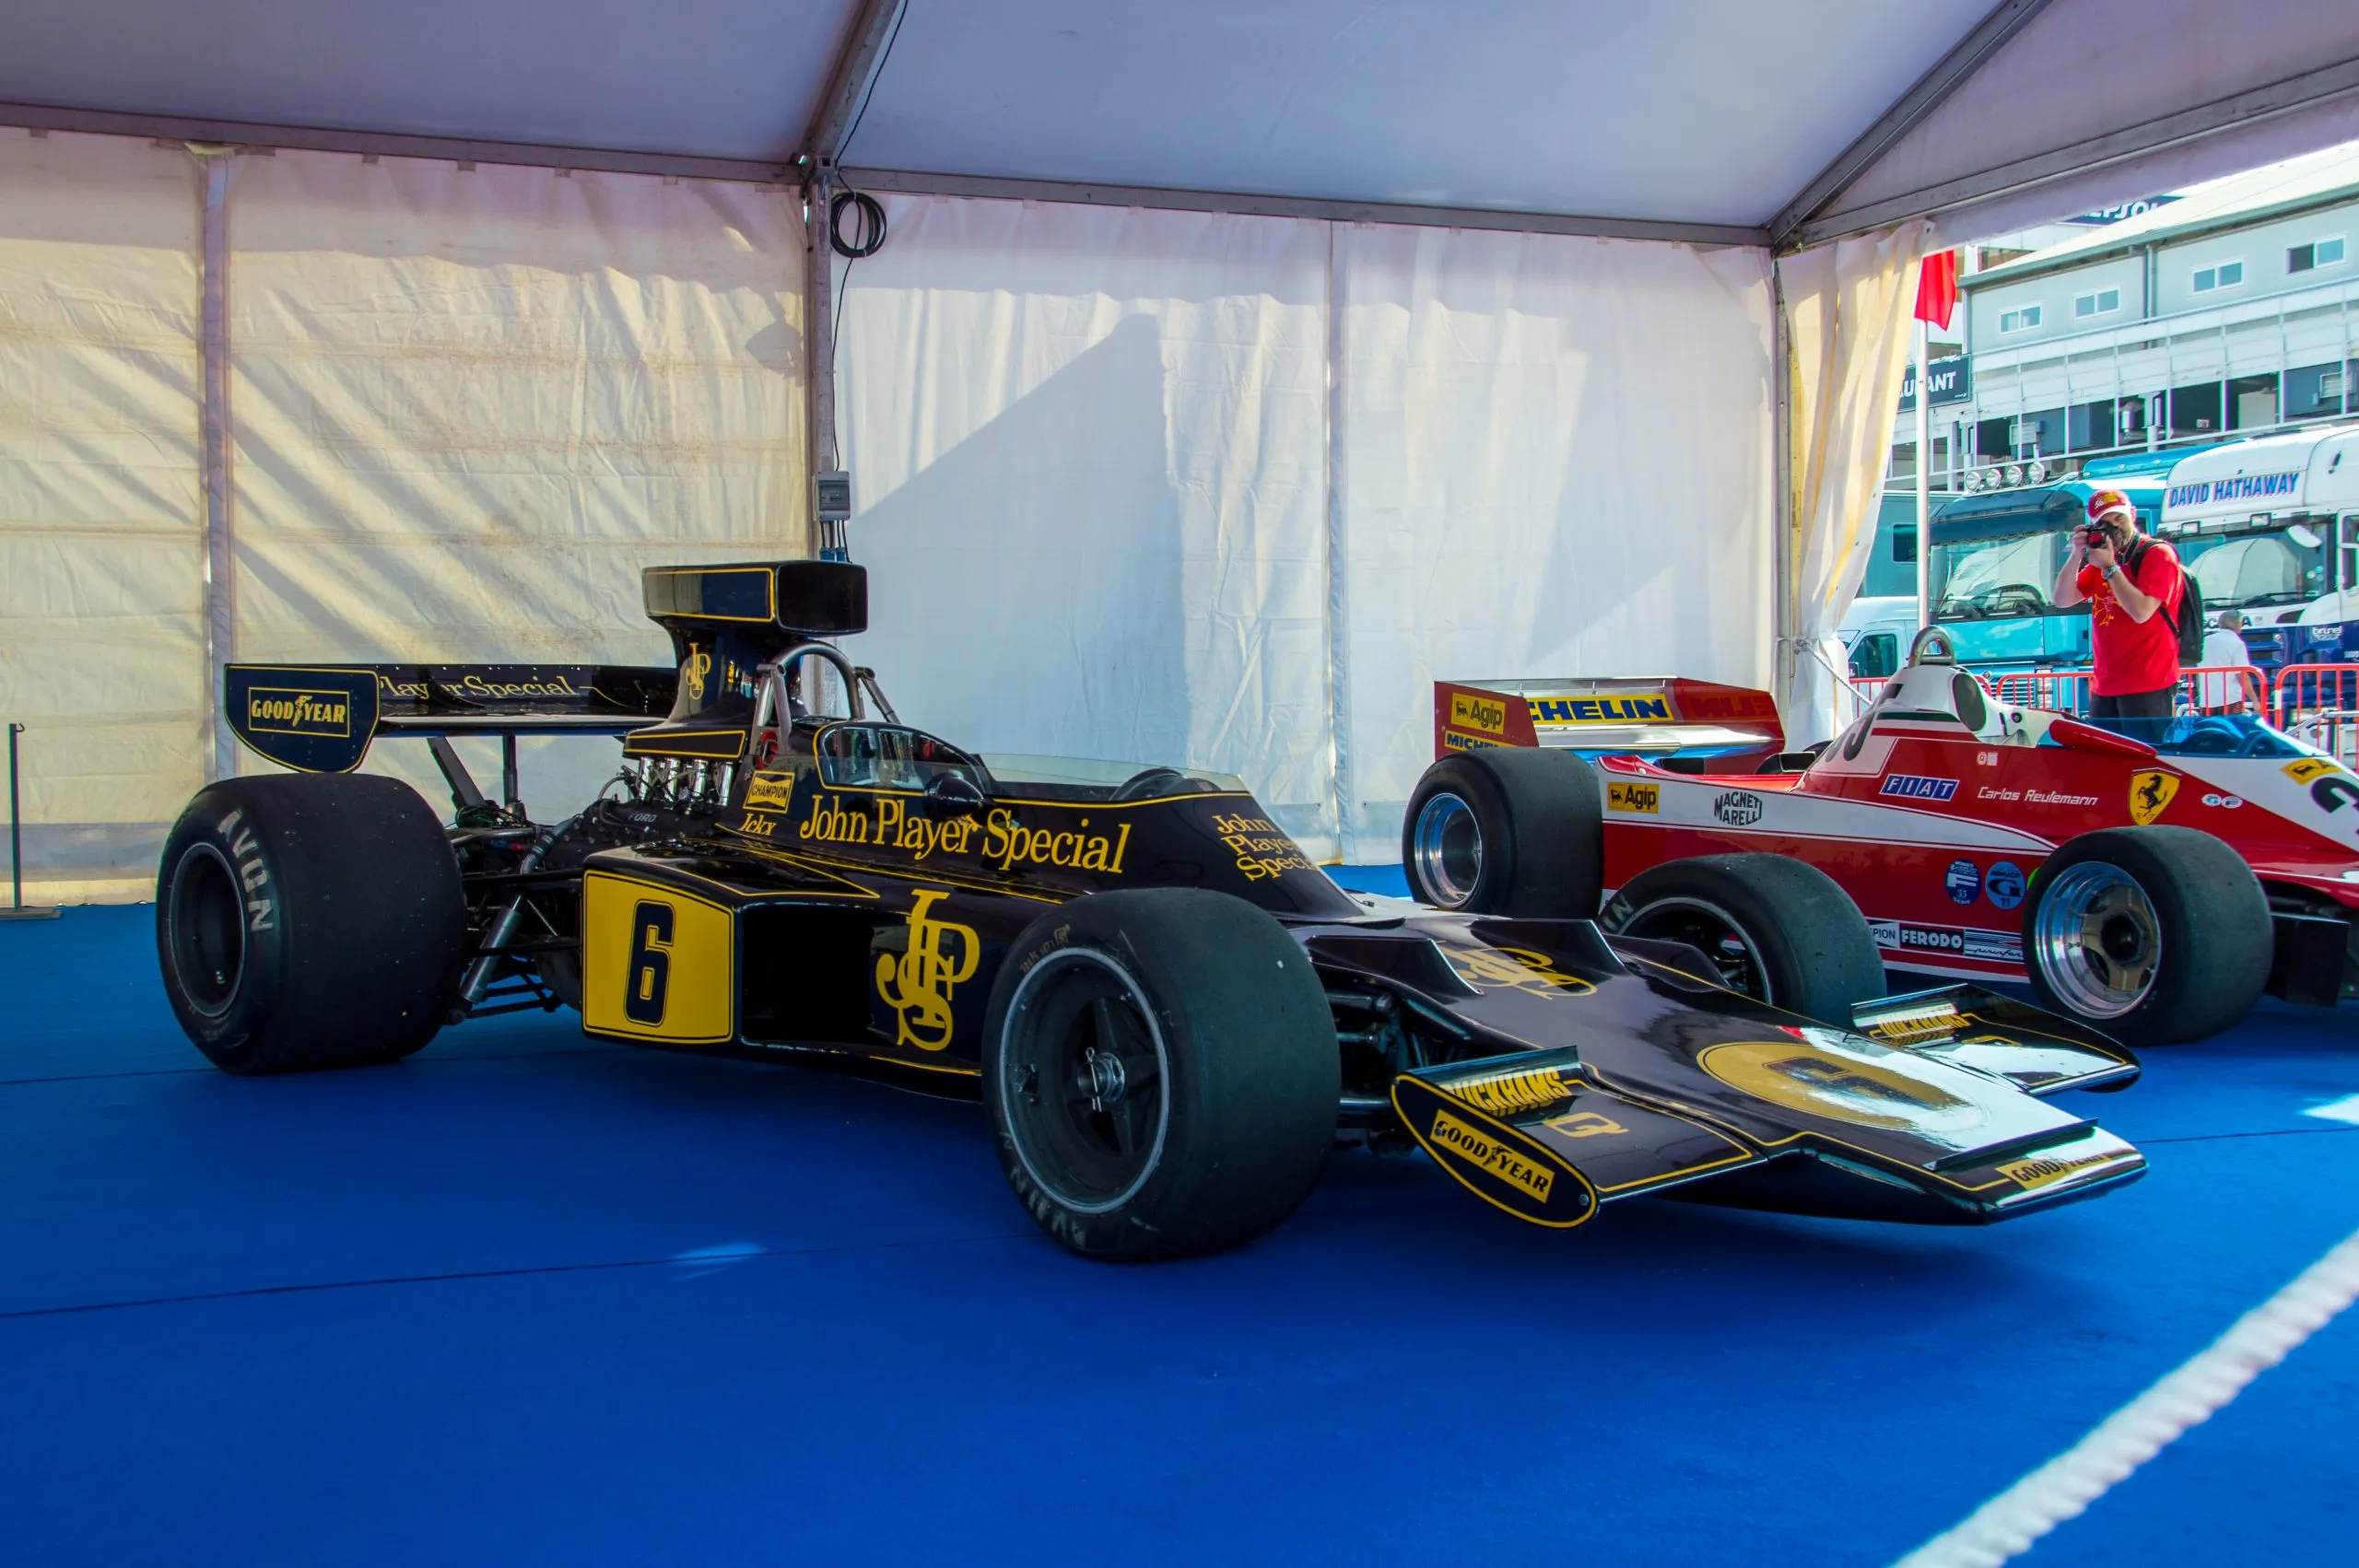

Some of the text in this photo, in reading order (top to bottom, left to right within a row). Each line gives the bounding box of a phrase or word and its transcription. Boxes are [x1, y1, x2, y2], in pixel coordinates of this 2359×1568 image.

[1899, 371, 1956, 398] UANT
[2168, 472, 2300, 508] DAVID HATHAWAY
[380, 675, 580, 700] layr Special
[1470, 699, 1503, 730] Agip
[752, 784, 789, 799] CHAMPION
[1624, 785, 1657, 811] Agip
[1886, 778, 1954, 798] FIAT
[1978, 787, 2099, 806] Carlos Reutemann
[799, 794, 1132, 873] John Player Special
[1212, 813, 1276, 834] John
[1221, 834, 1302, 855] Playe
[1871, 928, 1896, 940] PION
[1901, 930, 1963, 949] FERODO
[625, 900, 675, 1026] 6
[1542, 1111, 1629, 1138] Q
